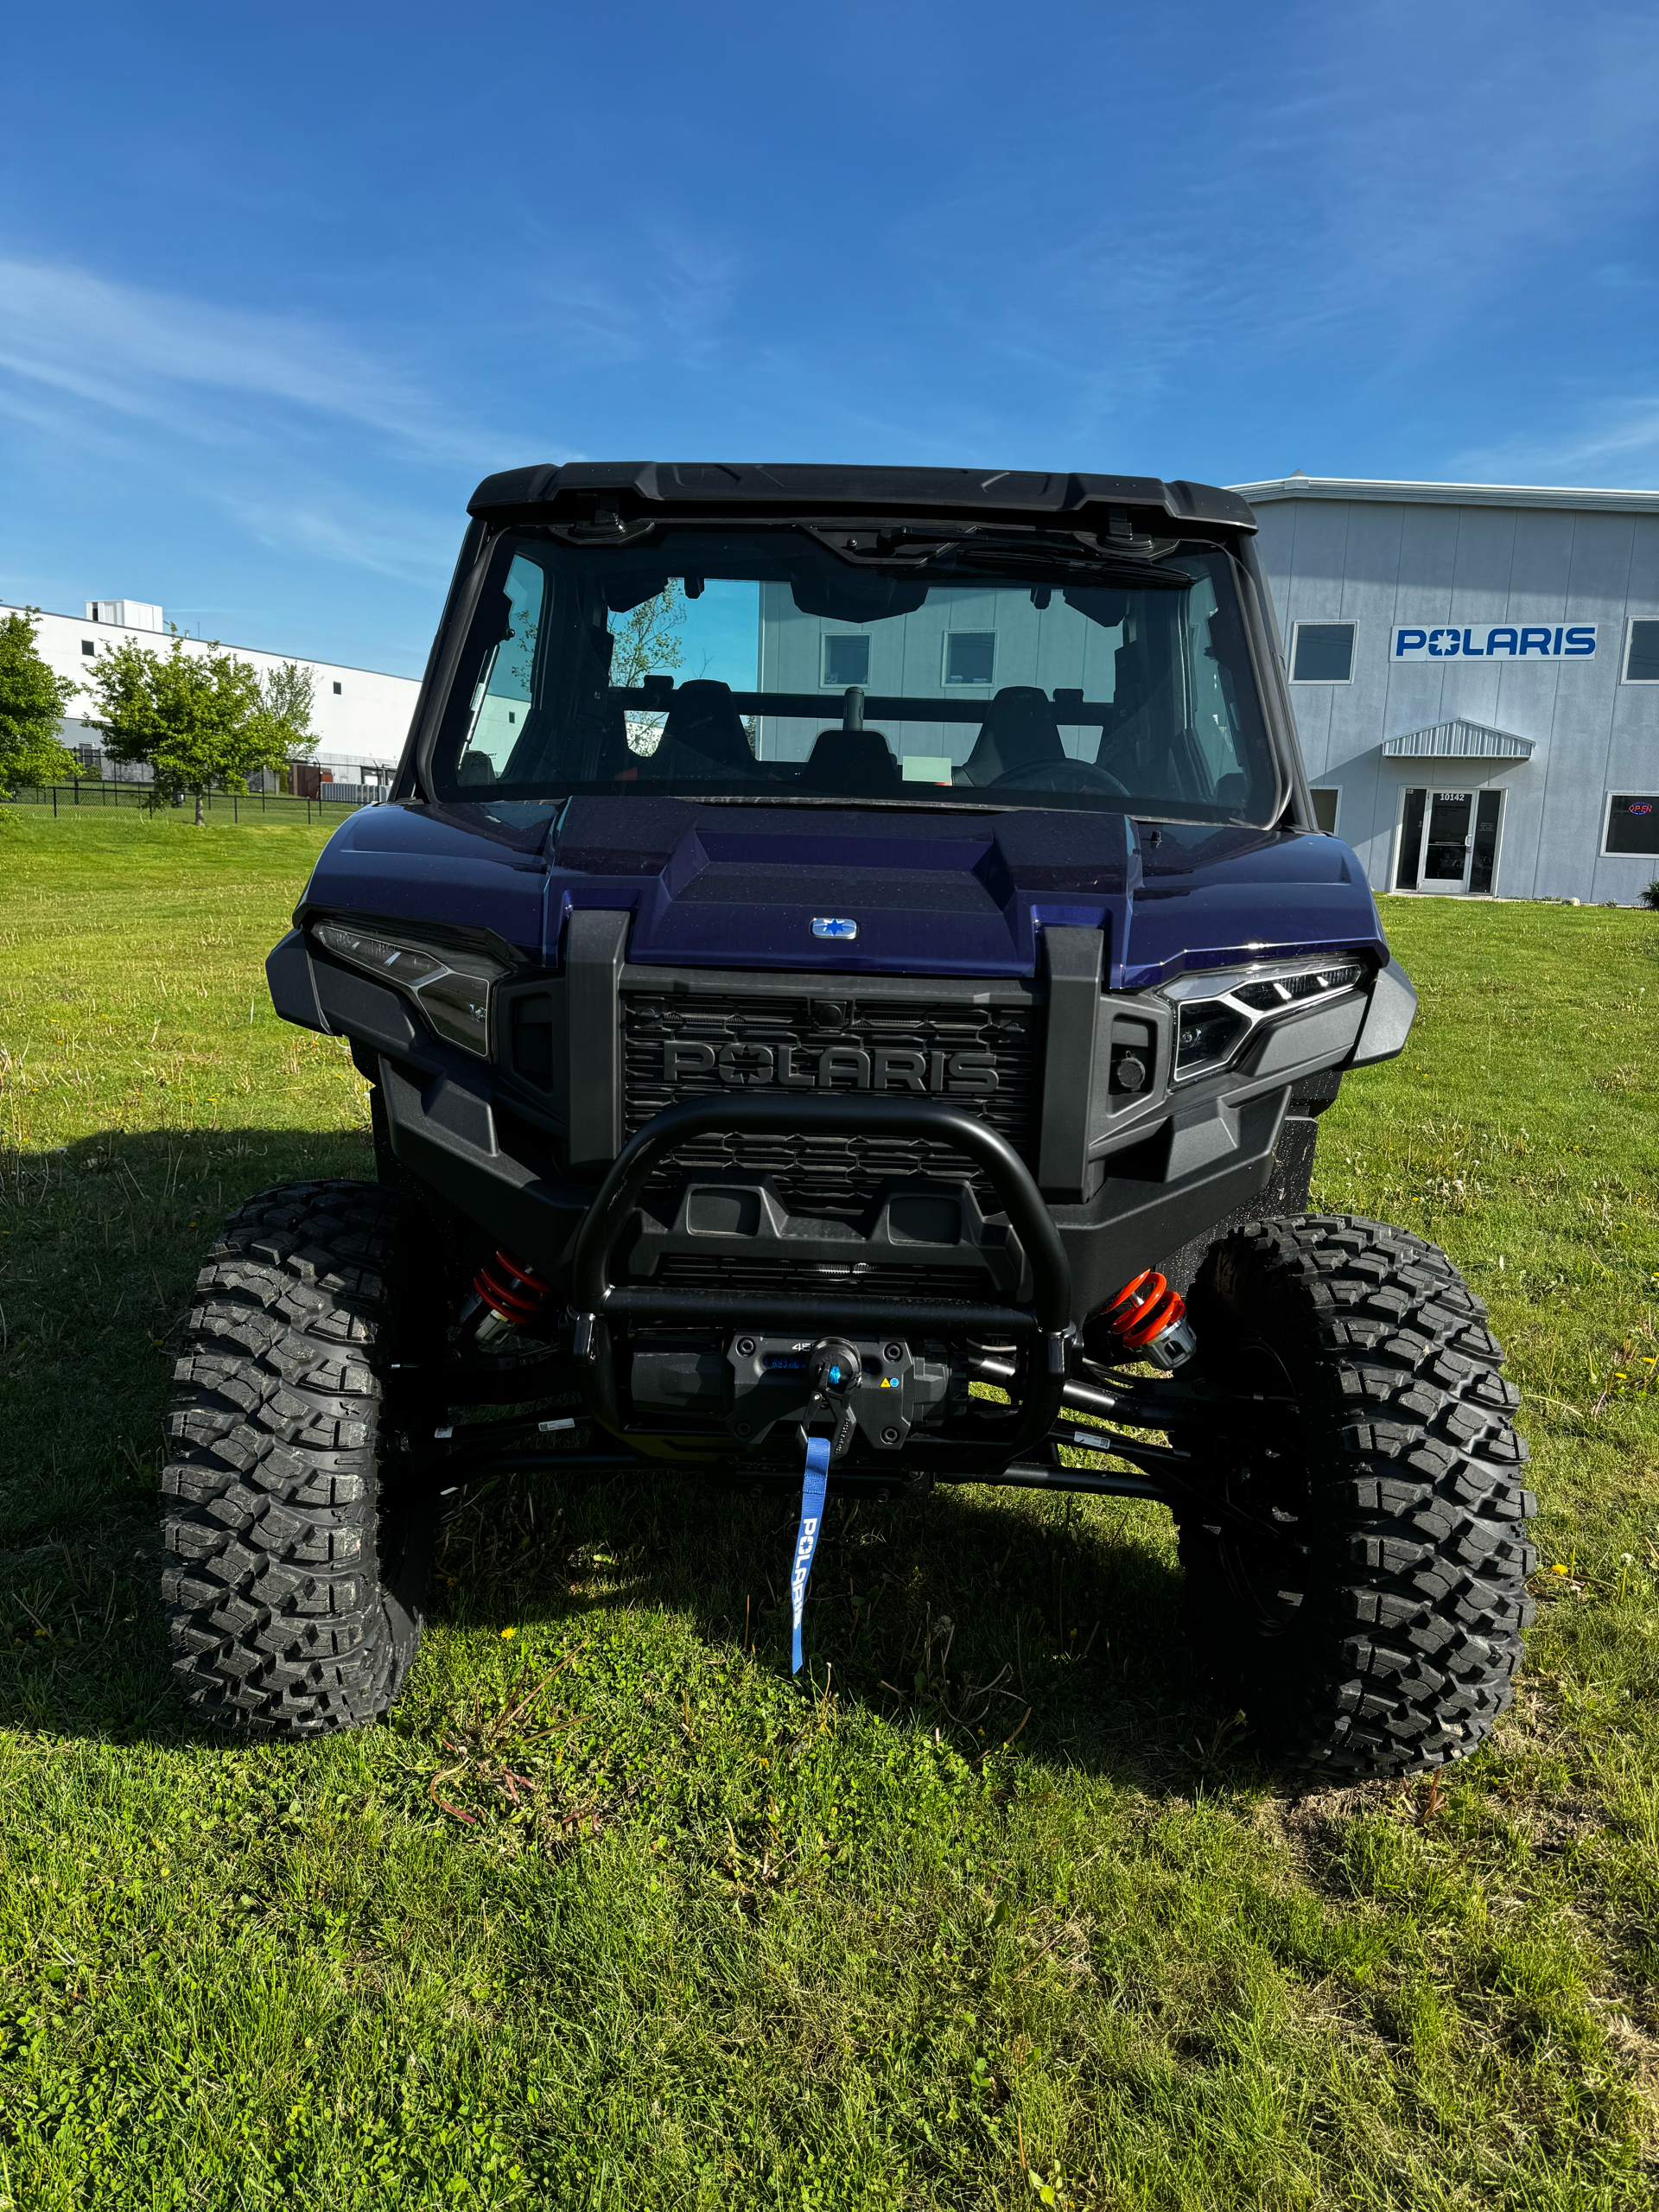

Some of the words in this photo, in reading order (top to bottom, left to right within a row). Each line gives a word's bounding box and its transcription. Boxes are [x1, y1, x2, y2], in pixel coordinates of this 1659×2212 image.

[1395, 627, 1596, 657] POLARIS
[1628, 804, 1652, 813] OPEN
[664, 1039, 1000, 1092] POLARIS
[791, 1343, 814, 1351] 45
